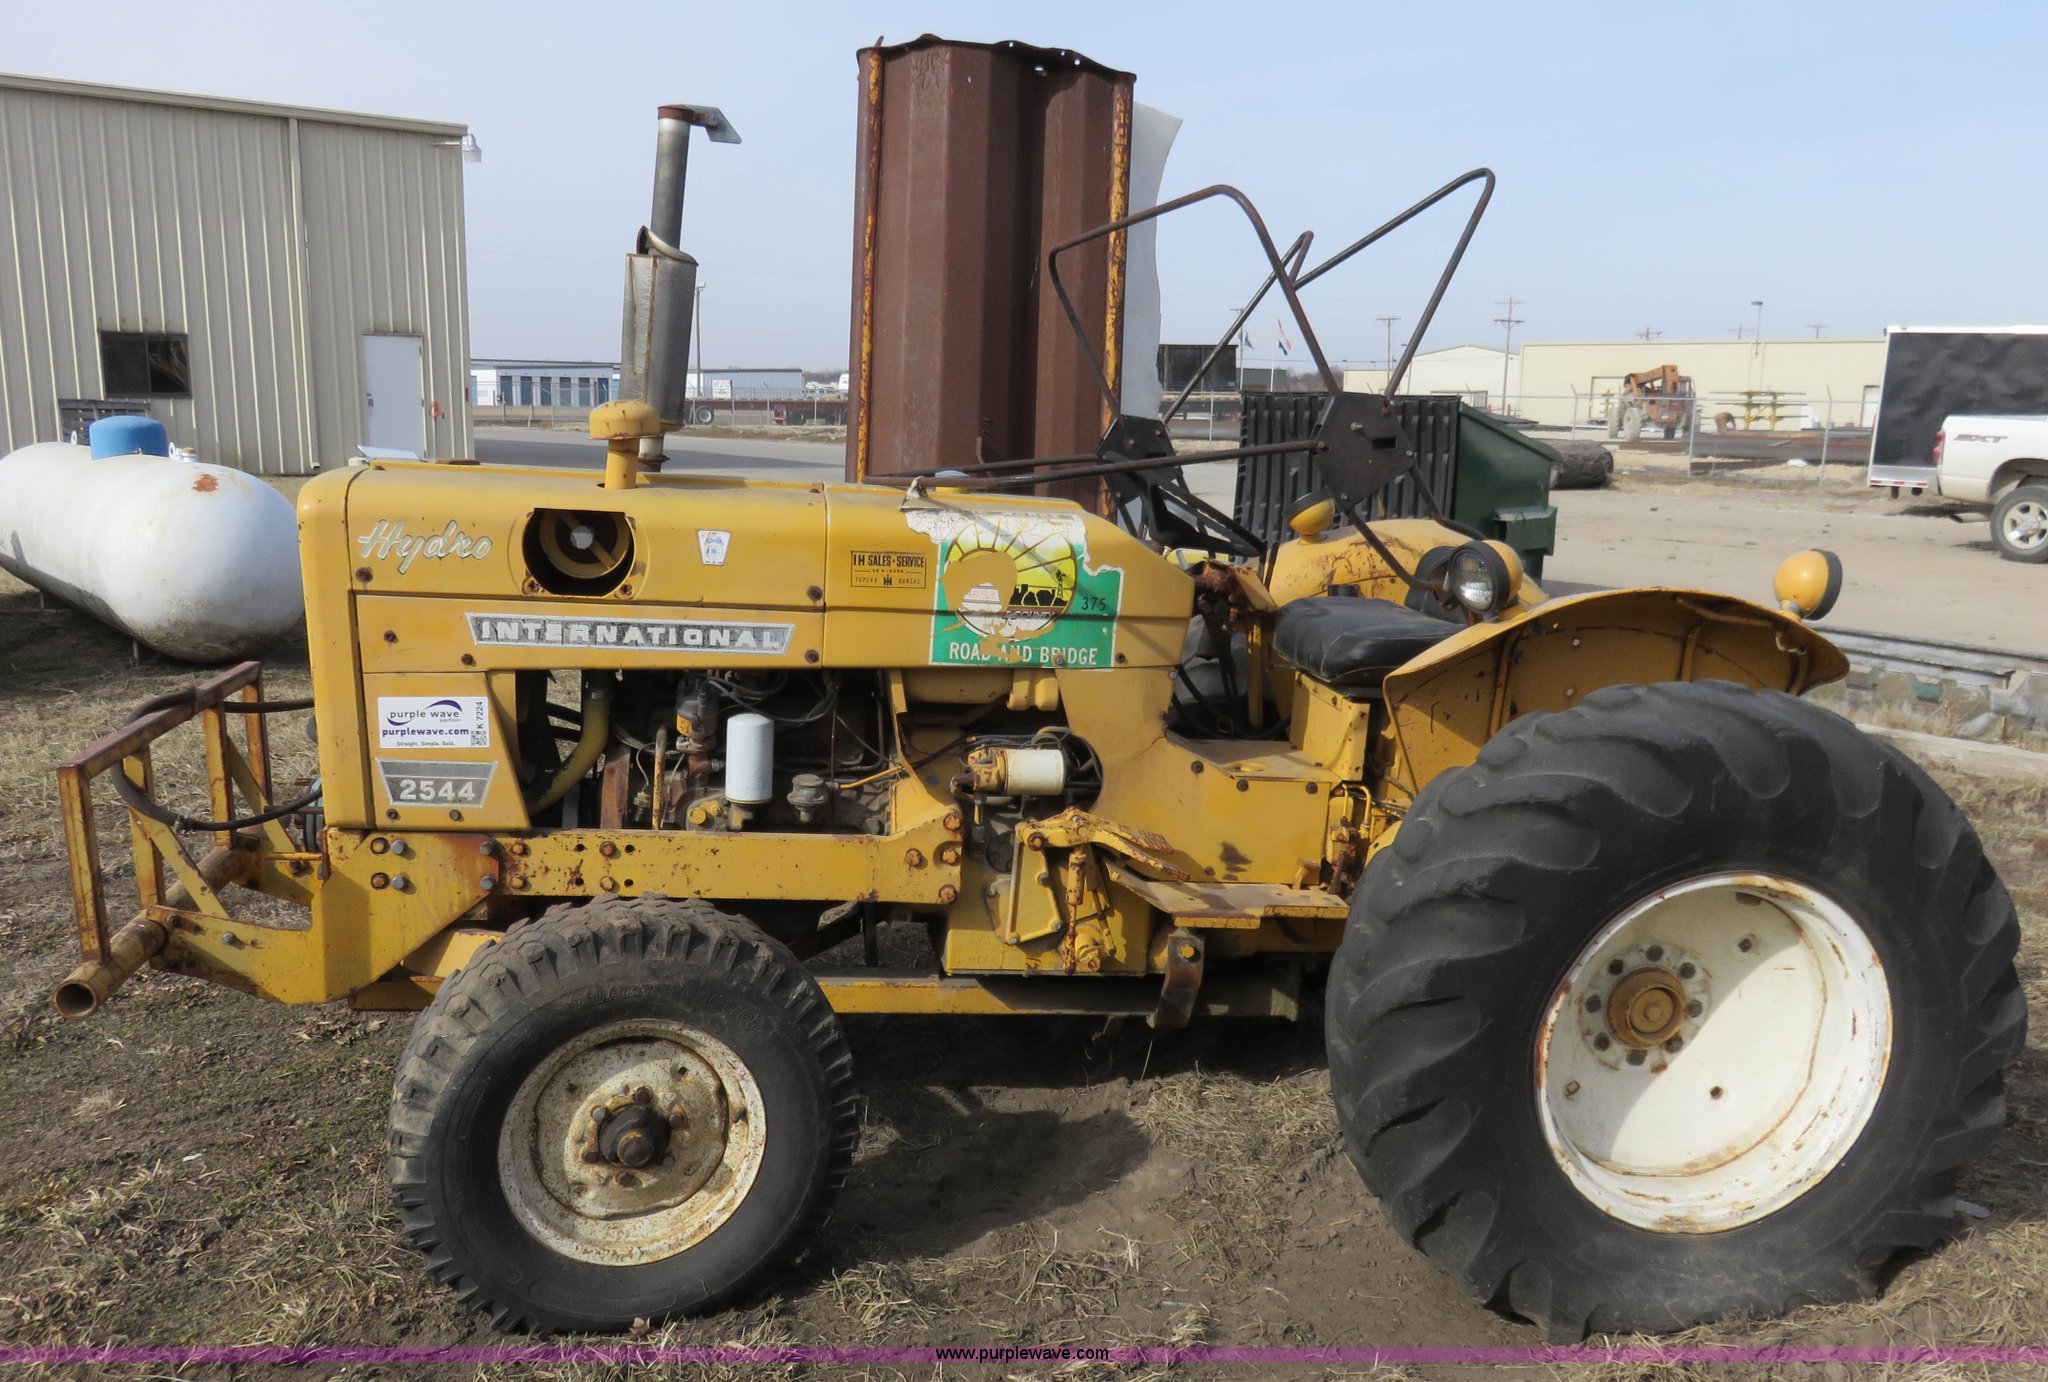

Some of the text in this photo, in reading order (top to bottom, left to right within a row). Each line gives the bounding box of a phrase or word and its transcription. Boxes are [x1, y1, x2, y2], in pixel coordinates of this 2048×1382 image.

[356, 518, 493, 576] Hydro
[868, 554, 892, 567] SALES
[896, 556, 925, 568] SERVICE
[1081, 596, 1106, 612] 375
[481, 620, 780, 649] INTERNATIONAL
[390, 710, 427, 720] purple
[475, 701, 484, 721] 7224
[382, 728, 469, 737] purplewave.com
[399, 779, 475, 801] 2544
